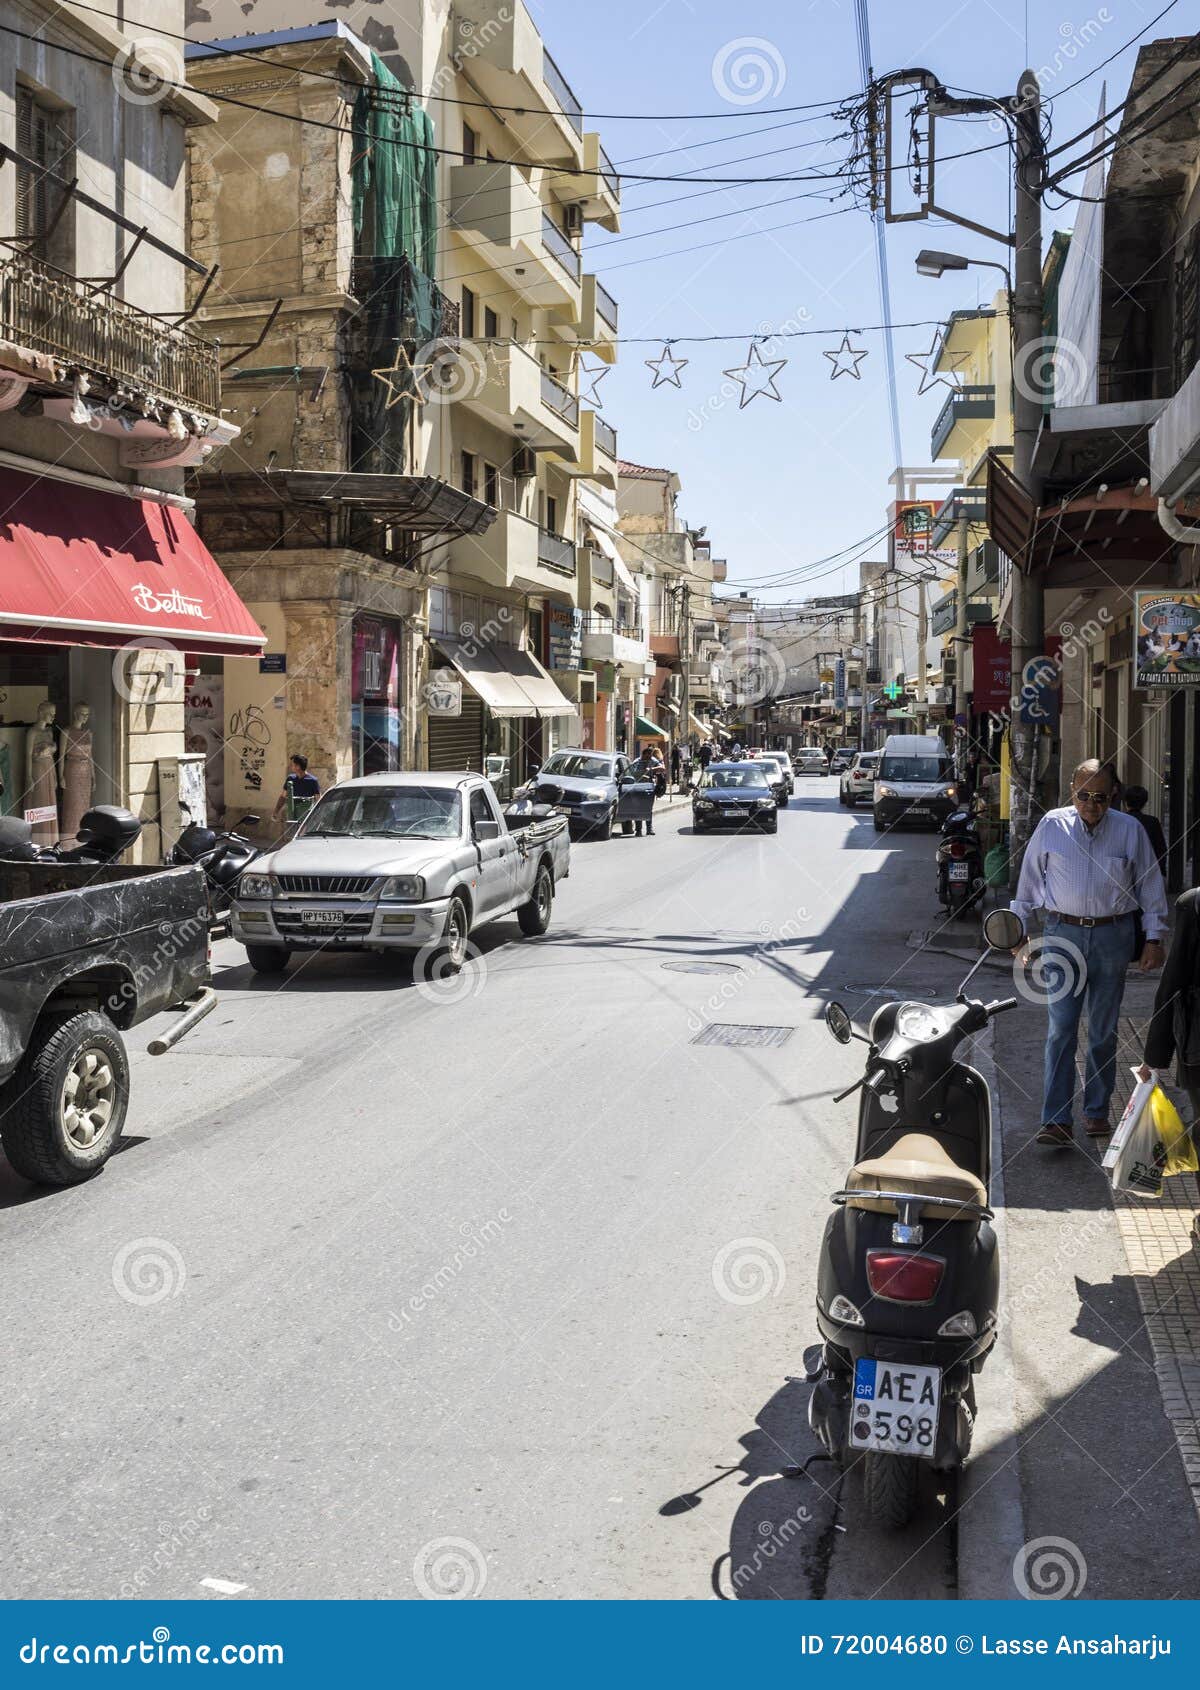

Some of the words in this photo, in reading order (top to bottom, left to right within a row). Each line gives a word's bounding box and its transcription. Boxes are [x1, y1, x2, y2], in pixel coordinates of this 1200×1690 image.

[131, 582, 213, 620] Bettina
[856, 1383, 873, 1396] GR
[878, 1369, 935, 1406] AEA
[874, 1410, 933, 1447] 598
